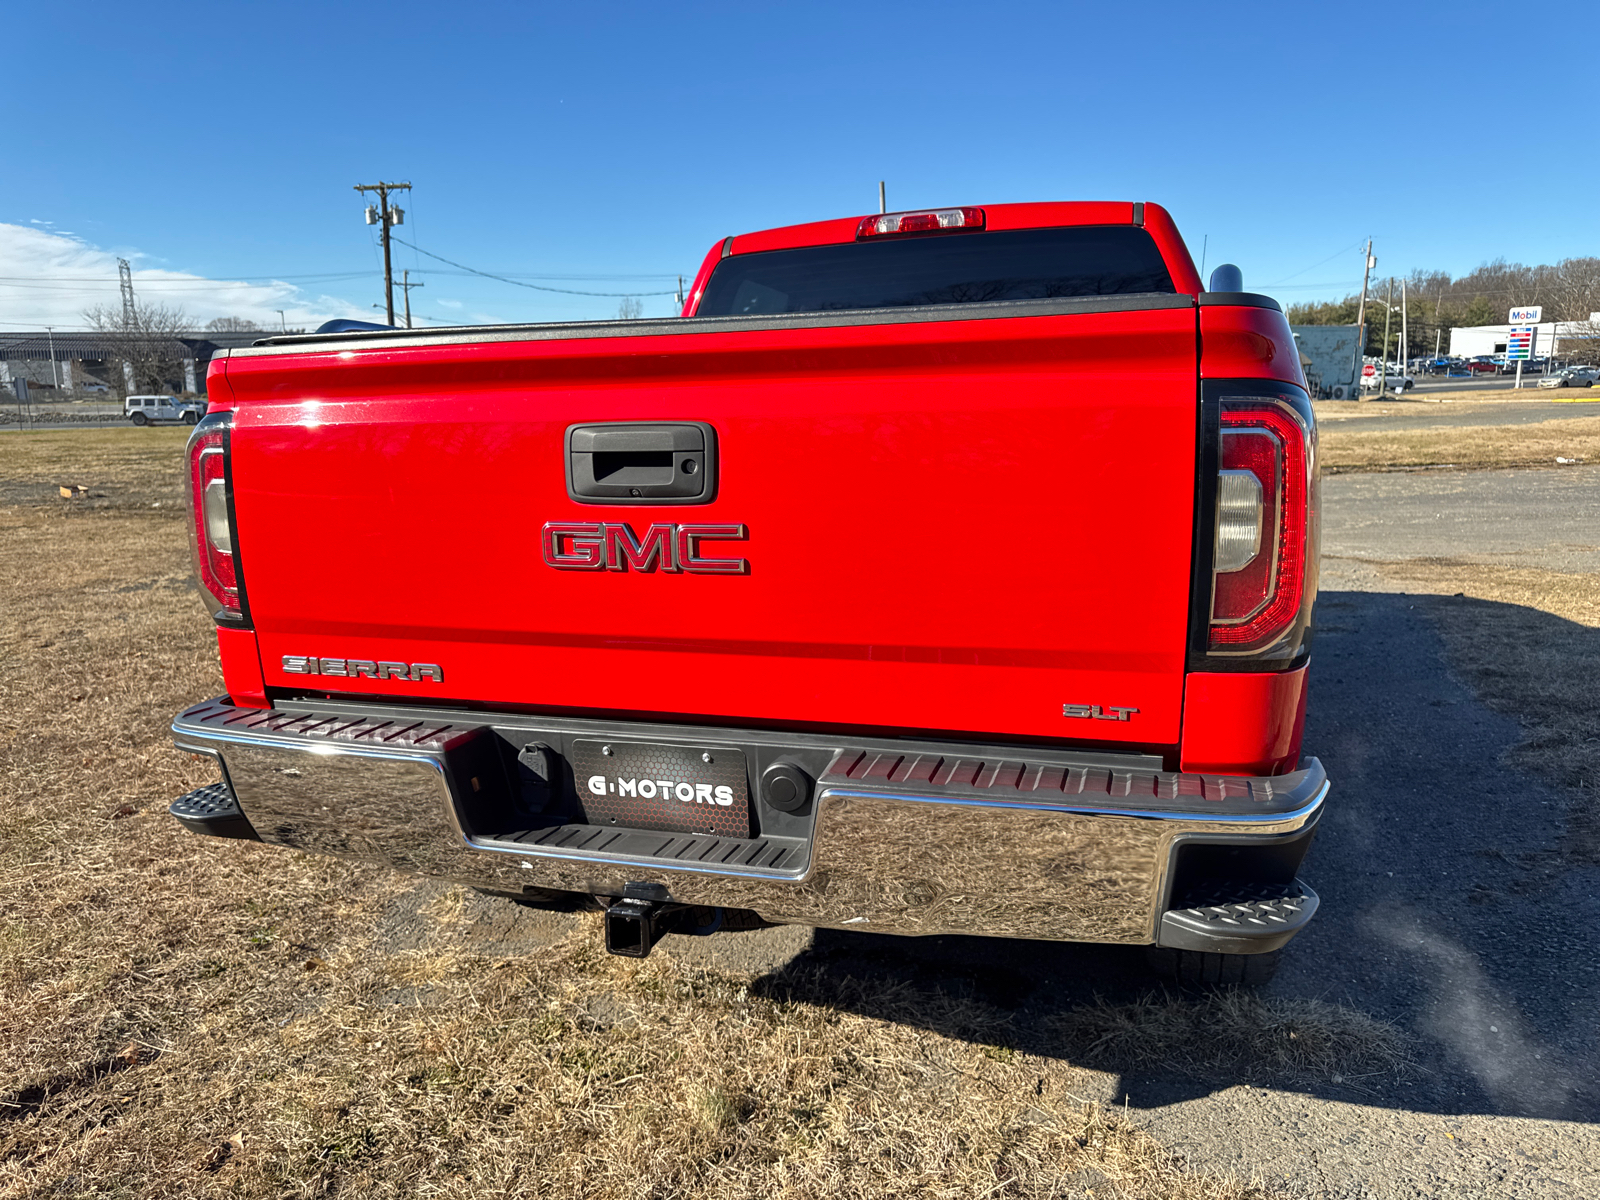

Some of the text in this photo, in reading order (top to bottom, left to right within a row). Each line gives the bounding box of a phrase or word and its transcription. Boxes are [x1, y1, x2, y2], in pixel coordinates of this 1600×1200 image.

[1512, 310, 1537, 320] Mobil
[541, 521, 745, 574] GMC
[282, 655, 444, 683] SIERRA
[1062, 703, 1139, 721] SLT
